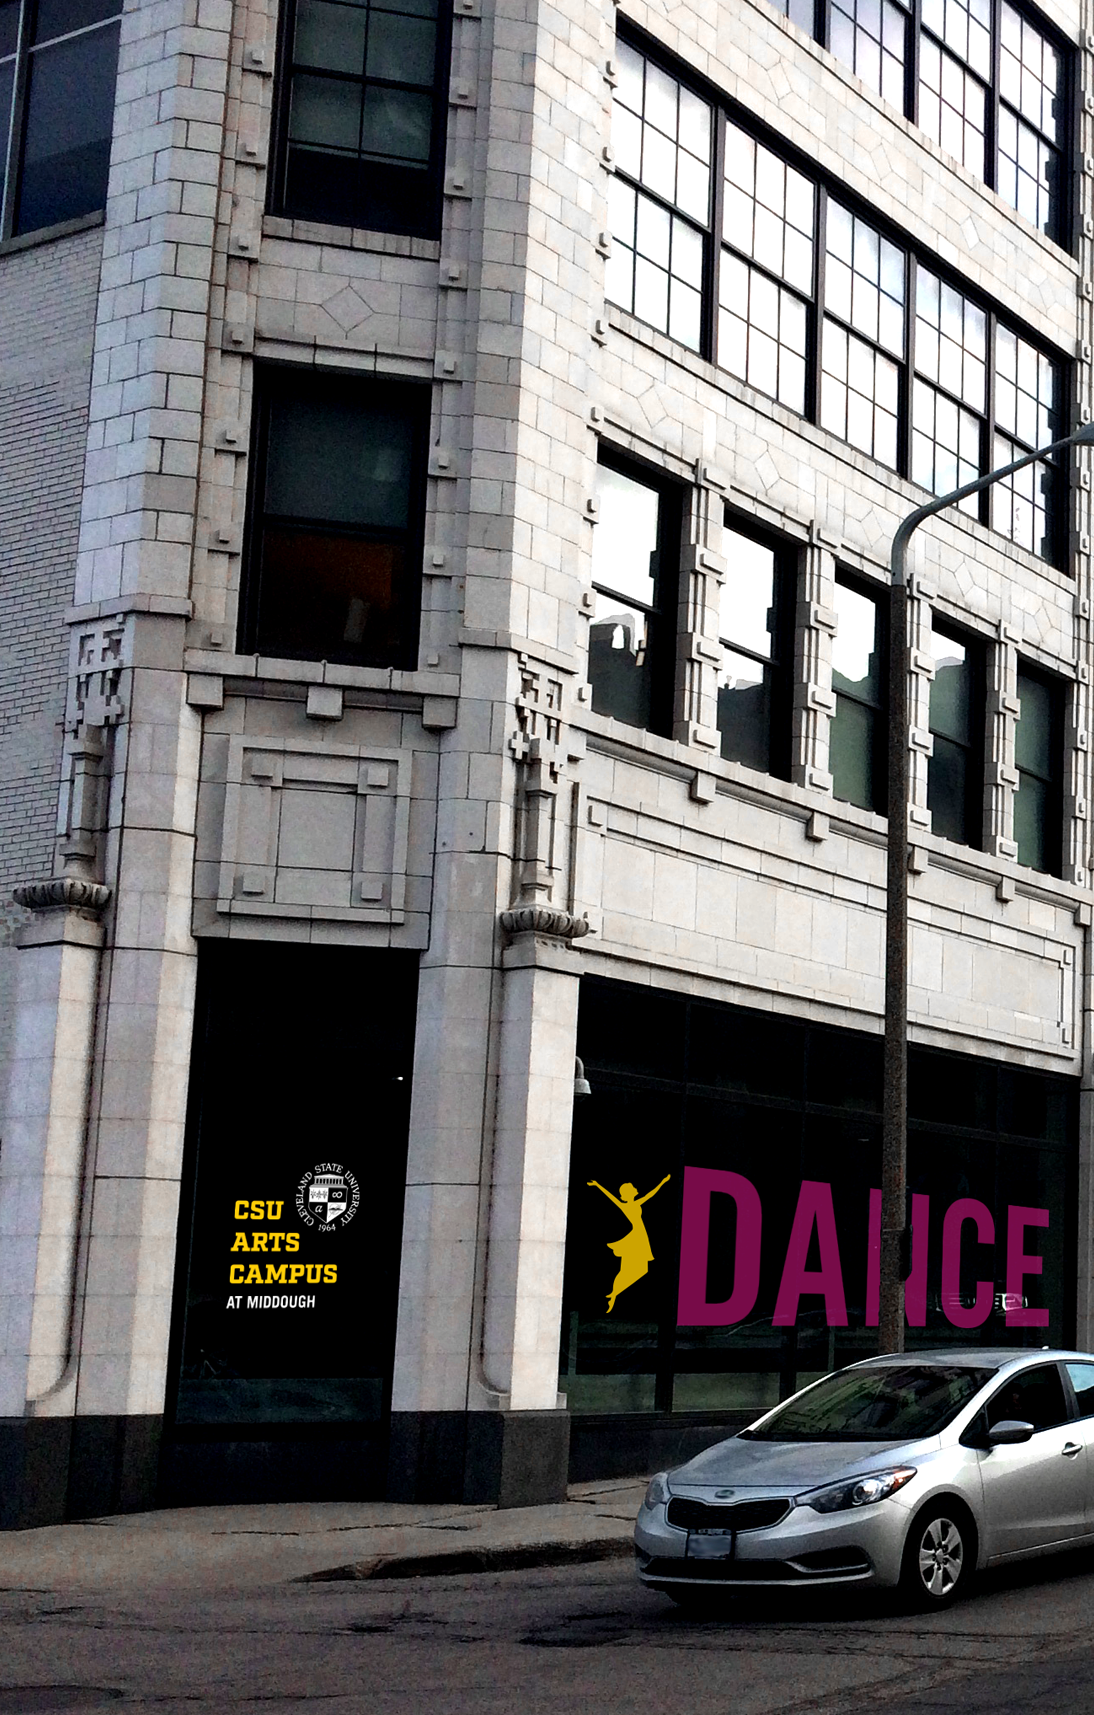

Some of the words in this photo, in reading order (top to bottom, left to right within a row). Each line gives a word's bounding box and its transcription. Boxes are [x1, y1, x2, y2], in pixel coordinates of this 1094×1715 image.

[296, 1171, 314, 1226] CLEVELAND
[315, 1163, 343, 1174] STATE
[340, 1170, 360, 1226] UNIVERSITY
[234, 1200, 284, 1220] CSU
[318, 1223, 336, 1232] 1964
[230, 1232, 300, 1252] ARTS
[676, 1165, 1049, 1328] DANCE
[229, 1264, 338, 1284] CAMPUS
[226, 1295, 243, 1309] AT
[247, 1295, 316, 1309] MIDDOUGH
